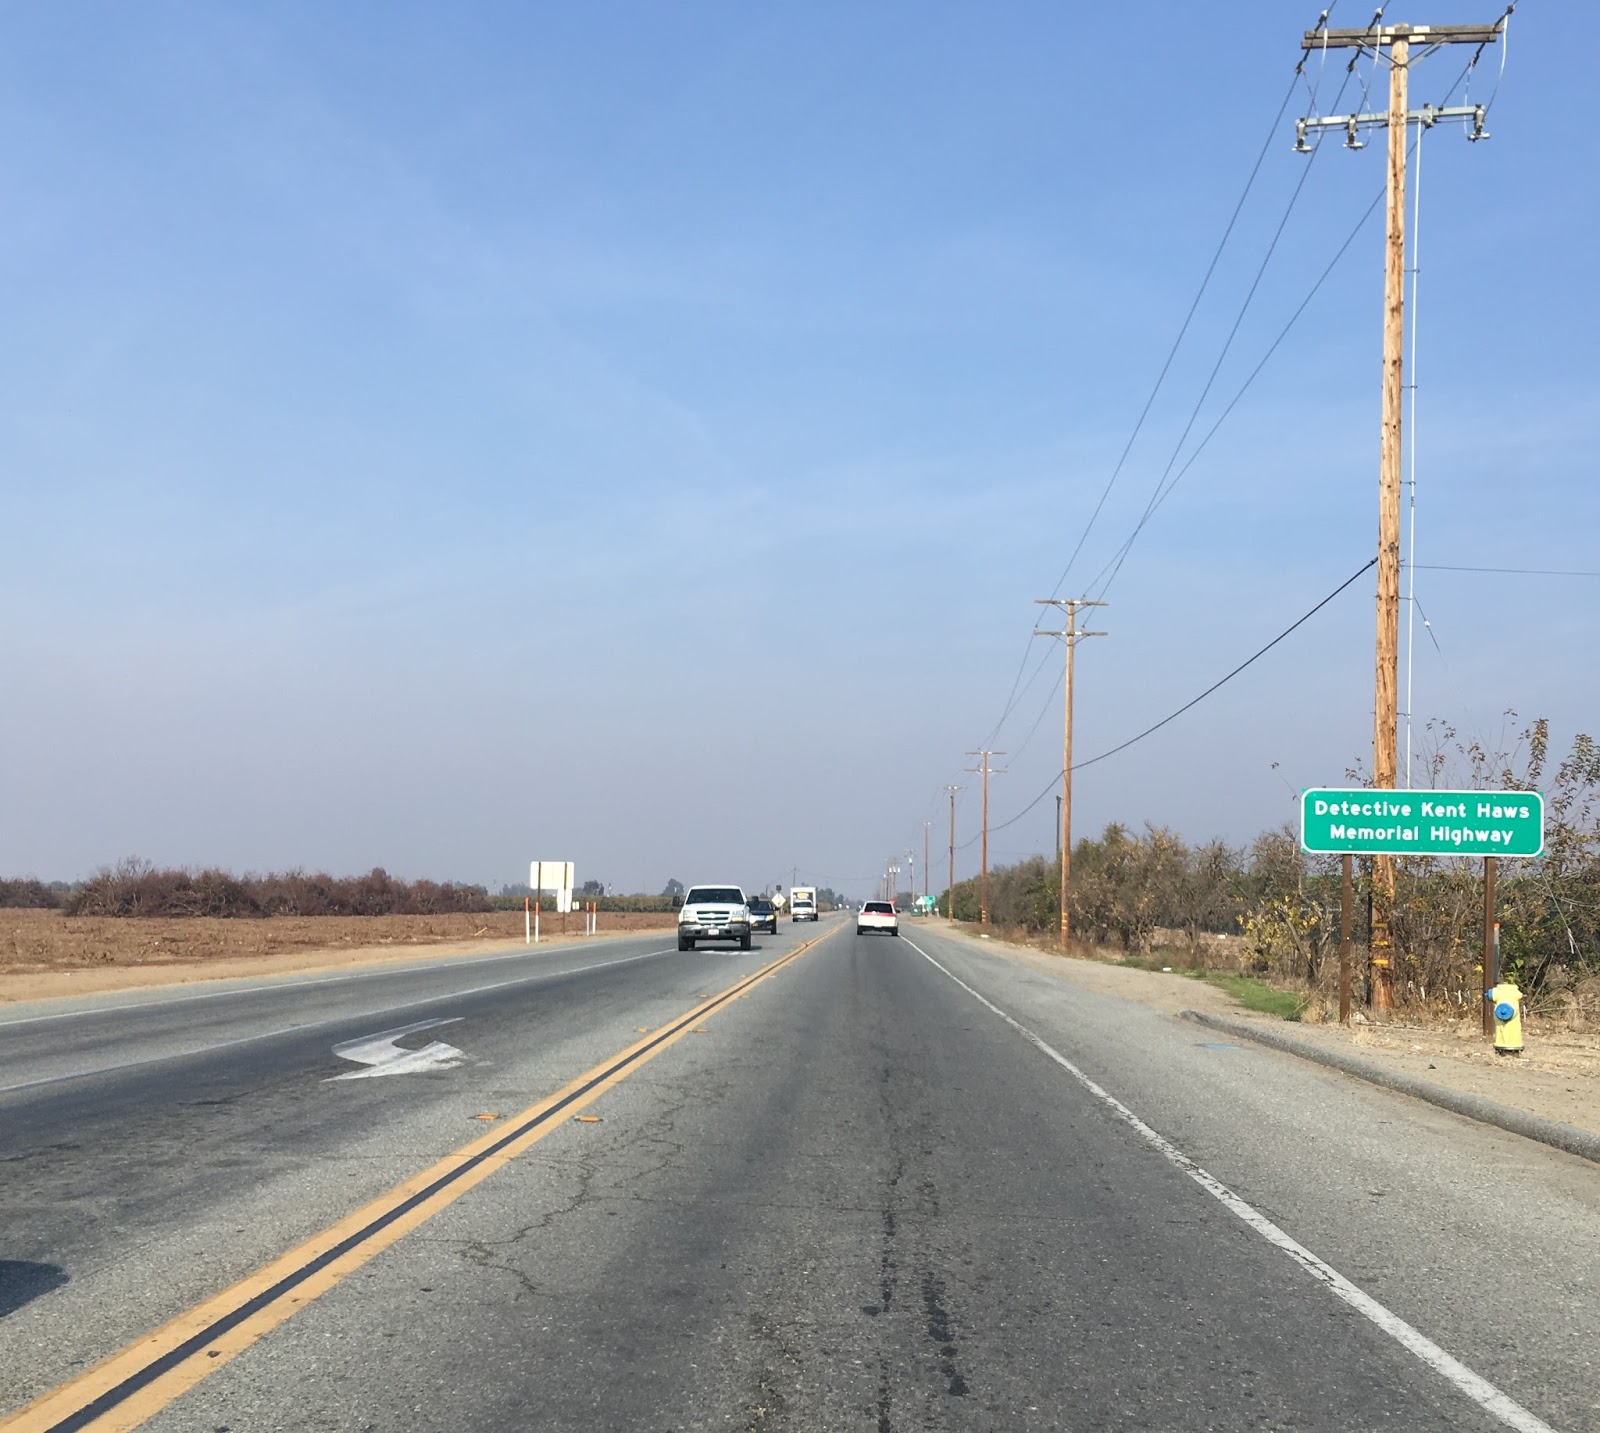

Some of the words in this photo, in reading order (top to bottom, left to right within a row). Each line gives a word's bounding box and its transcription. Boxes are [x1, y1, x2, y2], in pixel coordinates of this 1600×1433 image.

[1314, 800, 1412, 817] Detective
[1421, 802, 1466, 818] Kent
[1477, 803, 1530, 819] Haws
[1330, 824, 1419, 841] Memorial
[1430, 826, 1513, 846] Highway
